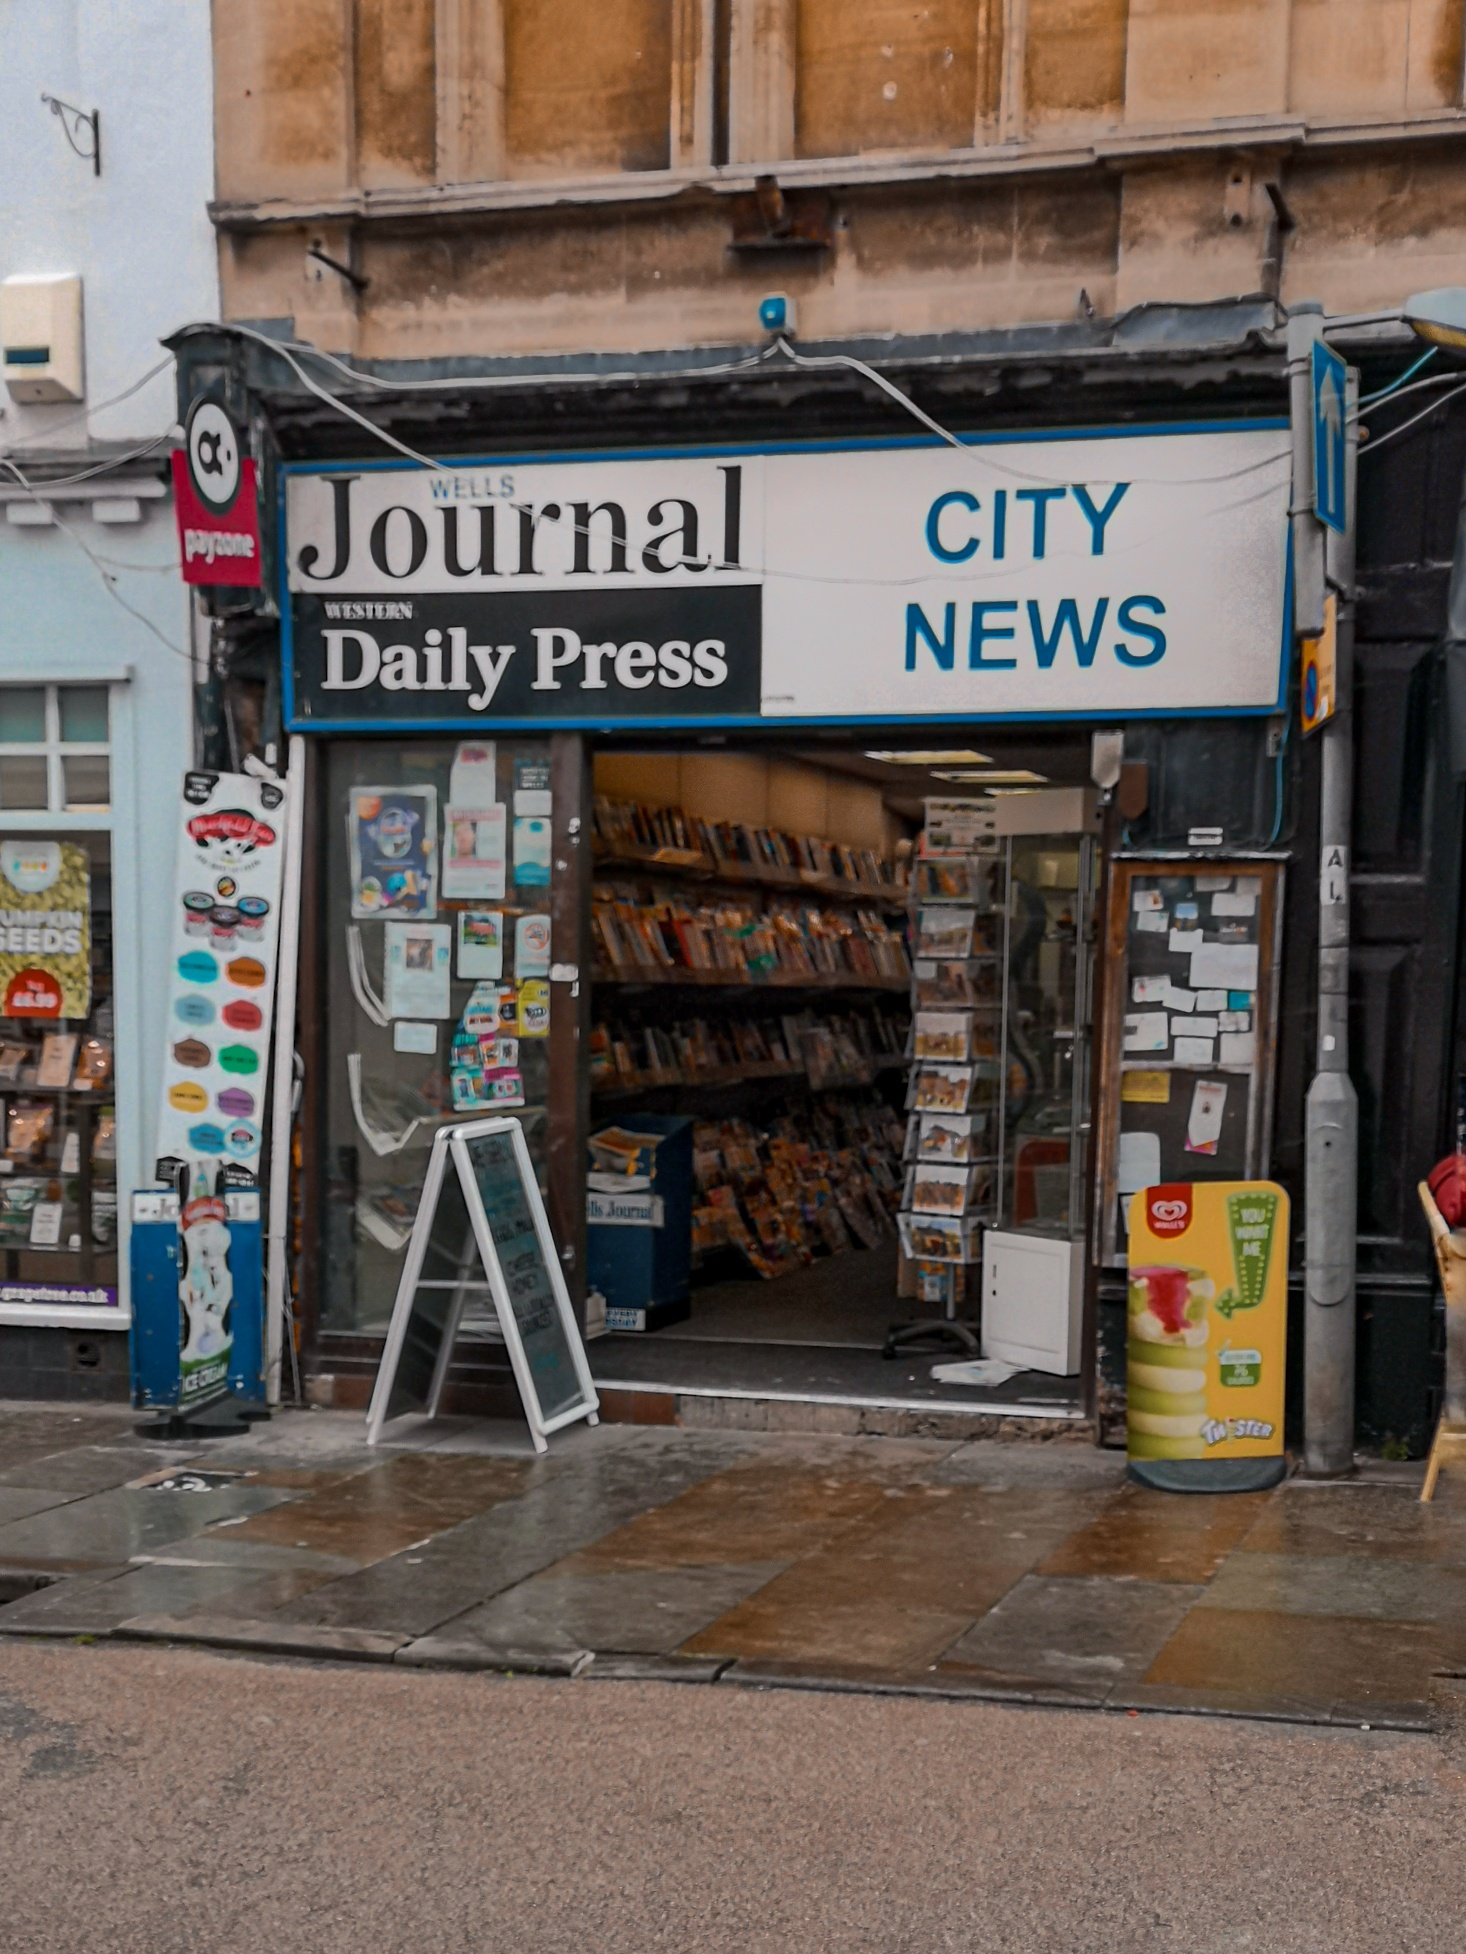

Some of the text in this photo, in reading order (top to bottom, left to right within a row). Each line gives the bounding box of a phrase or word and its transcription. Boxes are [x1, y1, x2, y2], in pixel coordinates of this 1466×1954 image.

[430, 475, 516, 499] WELLS
[299, 465, 744, 581] Journal
[925, 482, 1132, 564] CITY
[184, 527, 255, 564] payzone
[324, 601, 414, 620] WESTERN
[905, 594, 1167, 672] NEWS
[320, 626, 729, 711] Daily Press
[0, 928, 83, 954] EEDS
[1240, 1207, 1267, 1224] YOU
